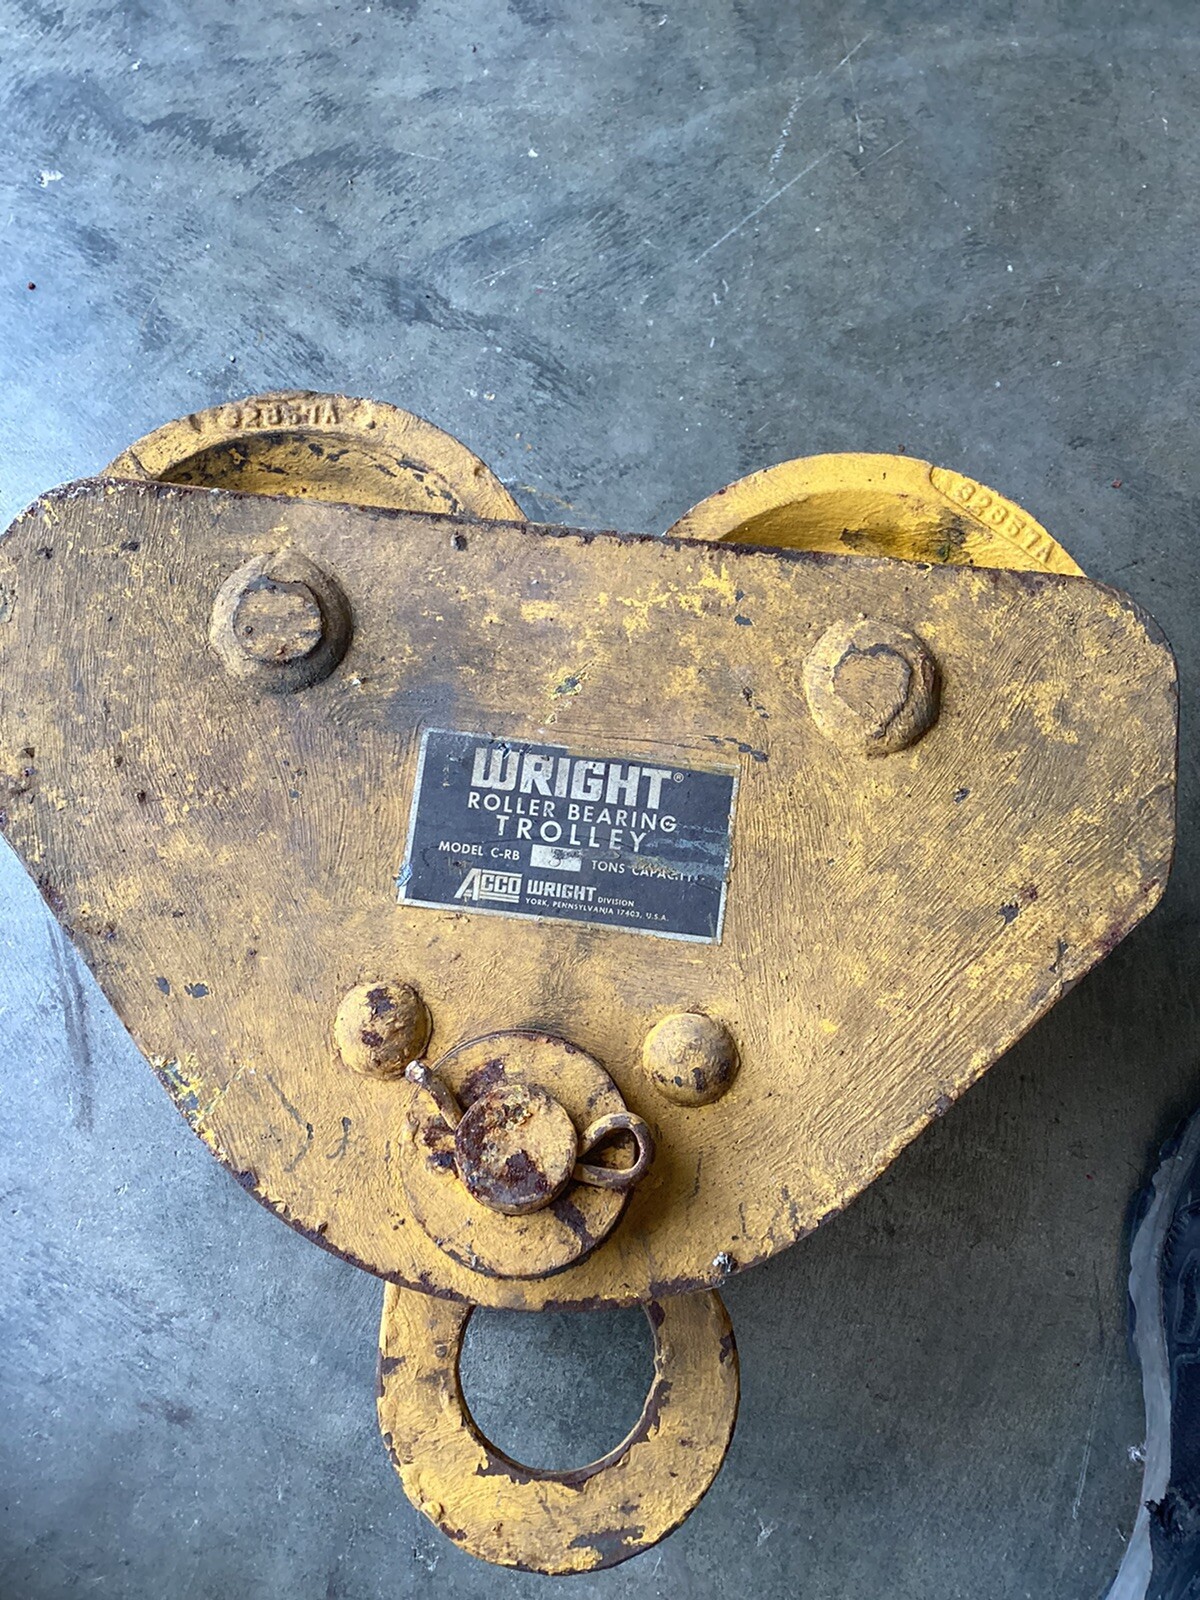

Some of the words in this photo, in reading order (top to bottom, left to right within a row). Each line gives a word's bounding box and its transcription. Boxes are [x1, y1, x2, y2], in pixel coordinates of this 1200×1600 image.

[467, 791, 556, 818] ROLLER
[567, 803, 678, 832] BEARING
[496, 814, 647, 853] TROLLEY
[438, 840, 483, 857] MODEL
[490, 847, 520, 861] C-RB
[591, 860, 625, 875] TONS
[454, 867, 523, 903] ACCO
[526, 879, 597, 902] WRIGHT
[597, 896, 635, 908] DIVISION
[525, 897, 550, 908] YORK,
[552, 901, 614, 916] PENNSYLVANIA
[645, 912, 669, 922] U.S.A.
